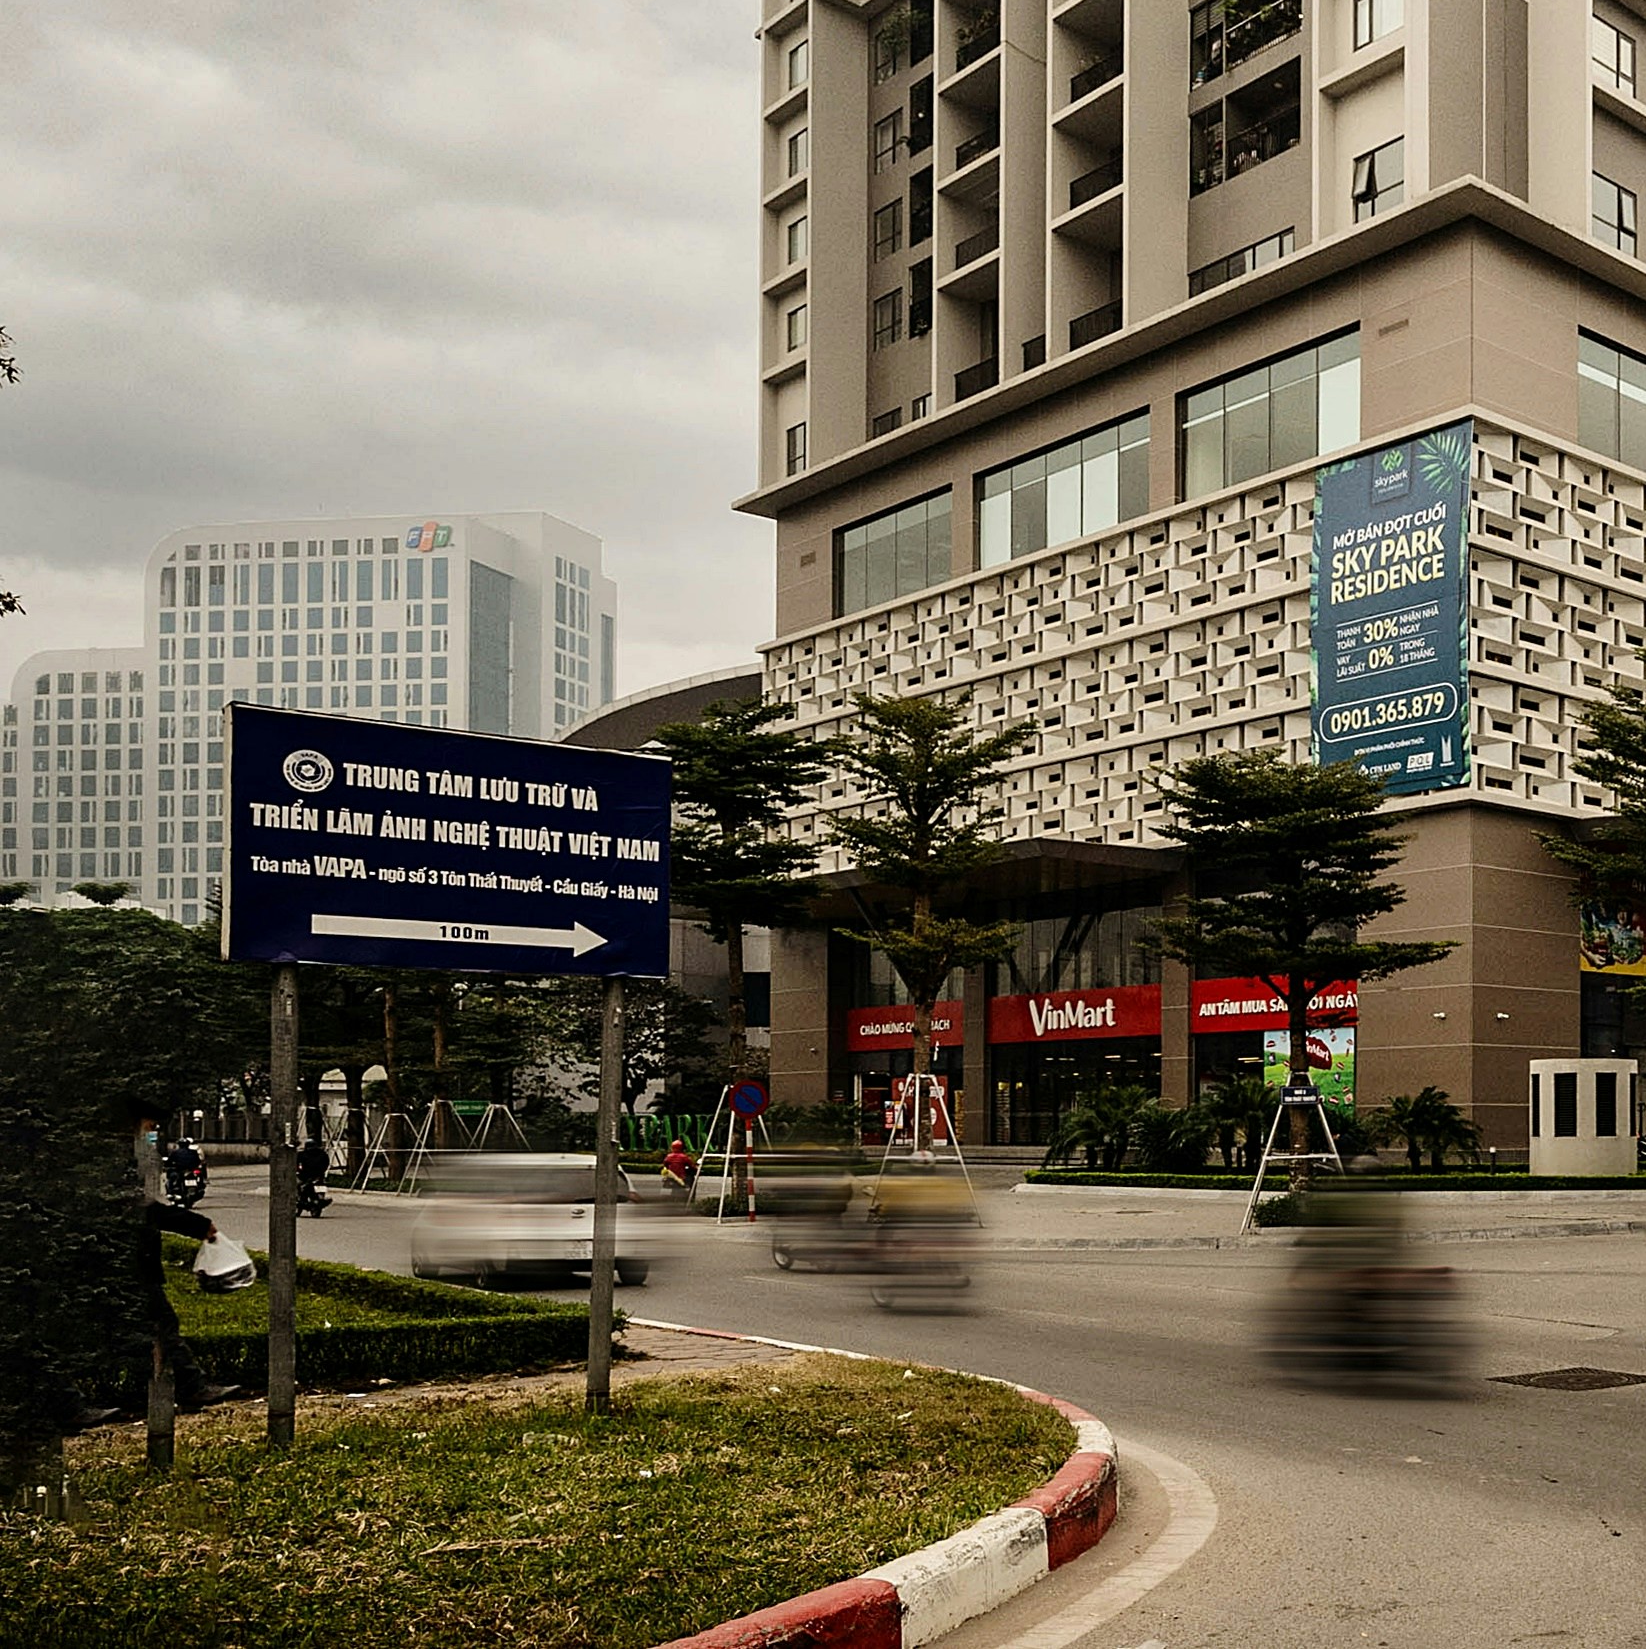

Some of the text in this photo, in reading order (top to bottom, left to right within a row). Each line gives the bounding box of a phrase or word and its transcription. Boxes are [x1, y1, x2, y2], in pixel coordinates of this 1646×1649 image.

[1333, 501, 1447, 550] MỞ BÁN ĐỢT CUỐI
[1331, 523, 1445, 579] SKY PARK
[1331, 553, 1445, 605] RESIDENCE
[1337, 626, 1361, 639] THANH
[1363, 616, 1399, 643] 30%
[1400, 623, 1421, 636] NGAY
[1368, 645, 1394, 669] 0%
[1400, 638, 1425, 651] TRONG
[1409, 647, 1435, 661] THÁNG
[1331, 691, 1445, 734] 0901.365.879
[343, 763, 420, 793] TRUNG
[426, 770, 473, 798] TÂM
[480, 777, 519, 802] LƯU
[525, 782, 568, 808] TRỮ
[571, 786, 598, 811] VÀ
[249, 799, 660, 862] TRIỂN LÃM ẢNH NGHỆ THUẬT VIỆT NAM
[250, 856, 279, 873] Tòa
[282, 858, 311, 875] nhà
[314, 855, 367, 879] VAPA
[378, 867, 406, 883] ngõ
[408, 866, 428, 884] số
[428, 870, 438, 885] 3
[440, 870, 466, 887] Tôn
[468, 871, 497, 889] Thất
[499, 875, 543, 893] Thuyết
[553, 878, 578, 895] Cầu
[581, 881, 608, 899] Giấy
[618, 885, 635, 899] Hà
[637, 887, 659, 904] Nội
[439, 925, 490, 940] 100m
[1029, 998, 1116, 1037] VinMart
[1199, 1003, 1217, 1016] AN
[1217, 998, 1240, 1015] TÂM
[1242, 1000, 1267, 1014] MUA
[860, 1022, 881, 1036] CHÀO
